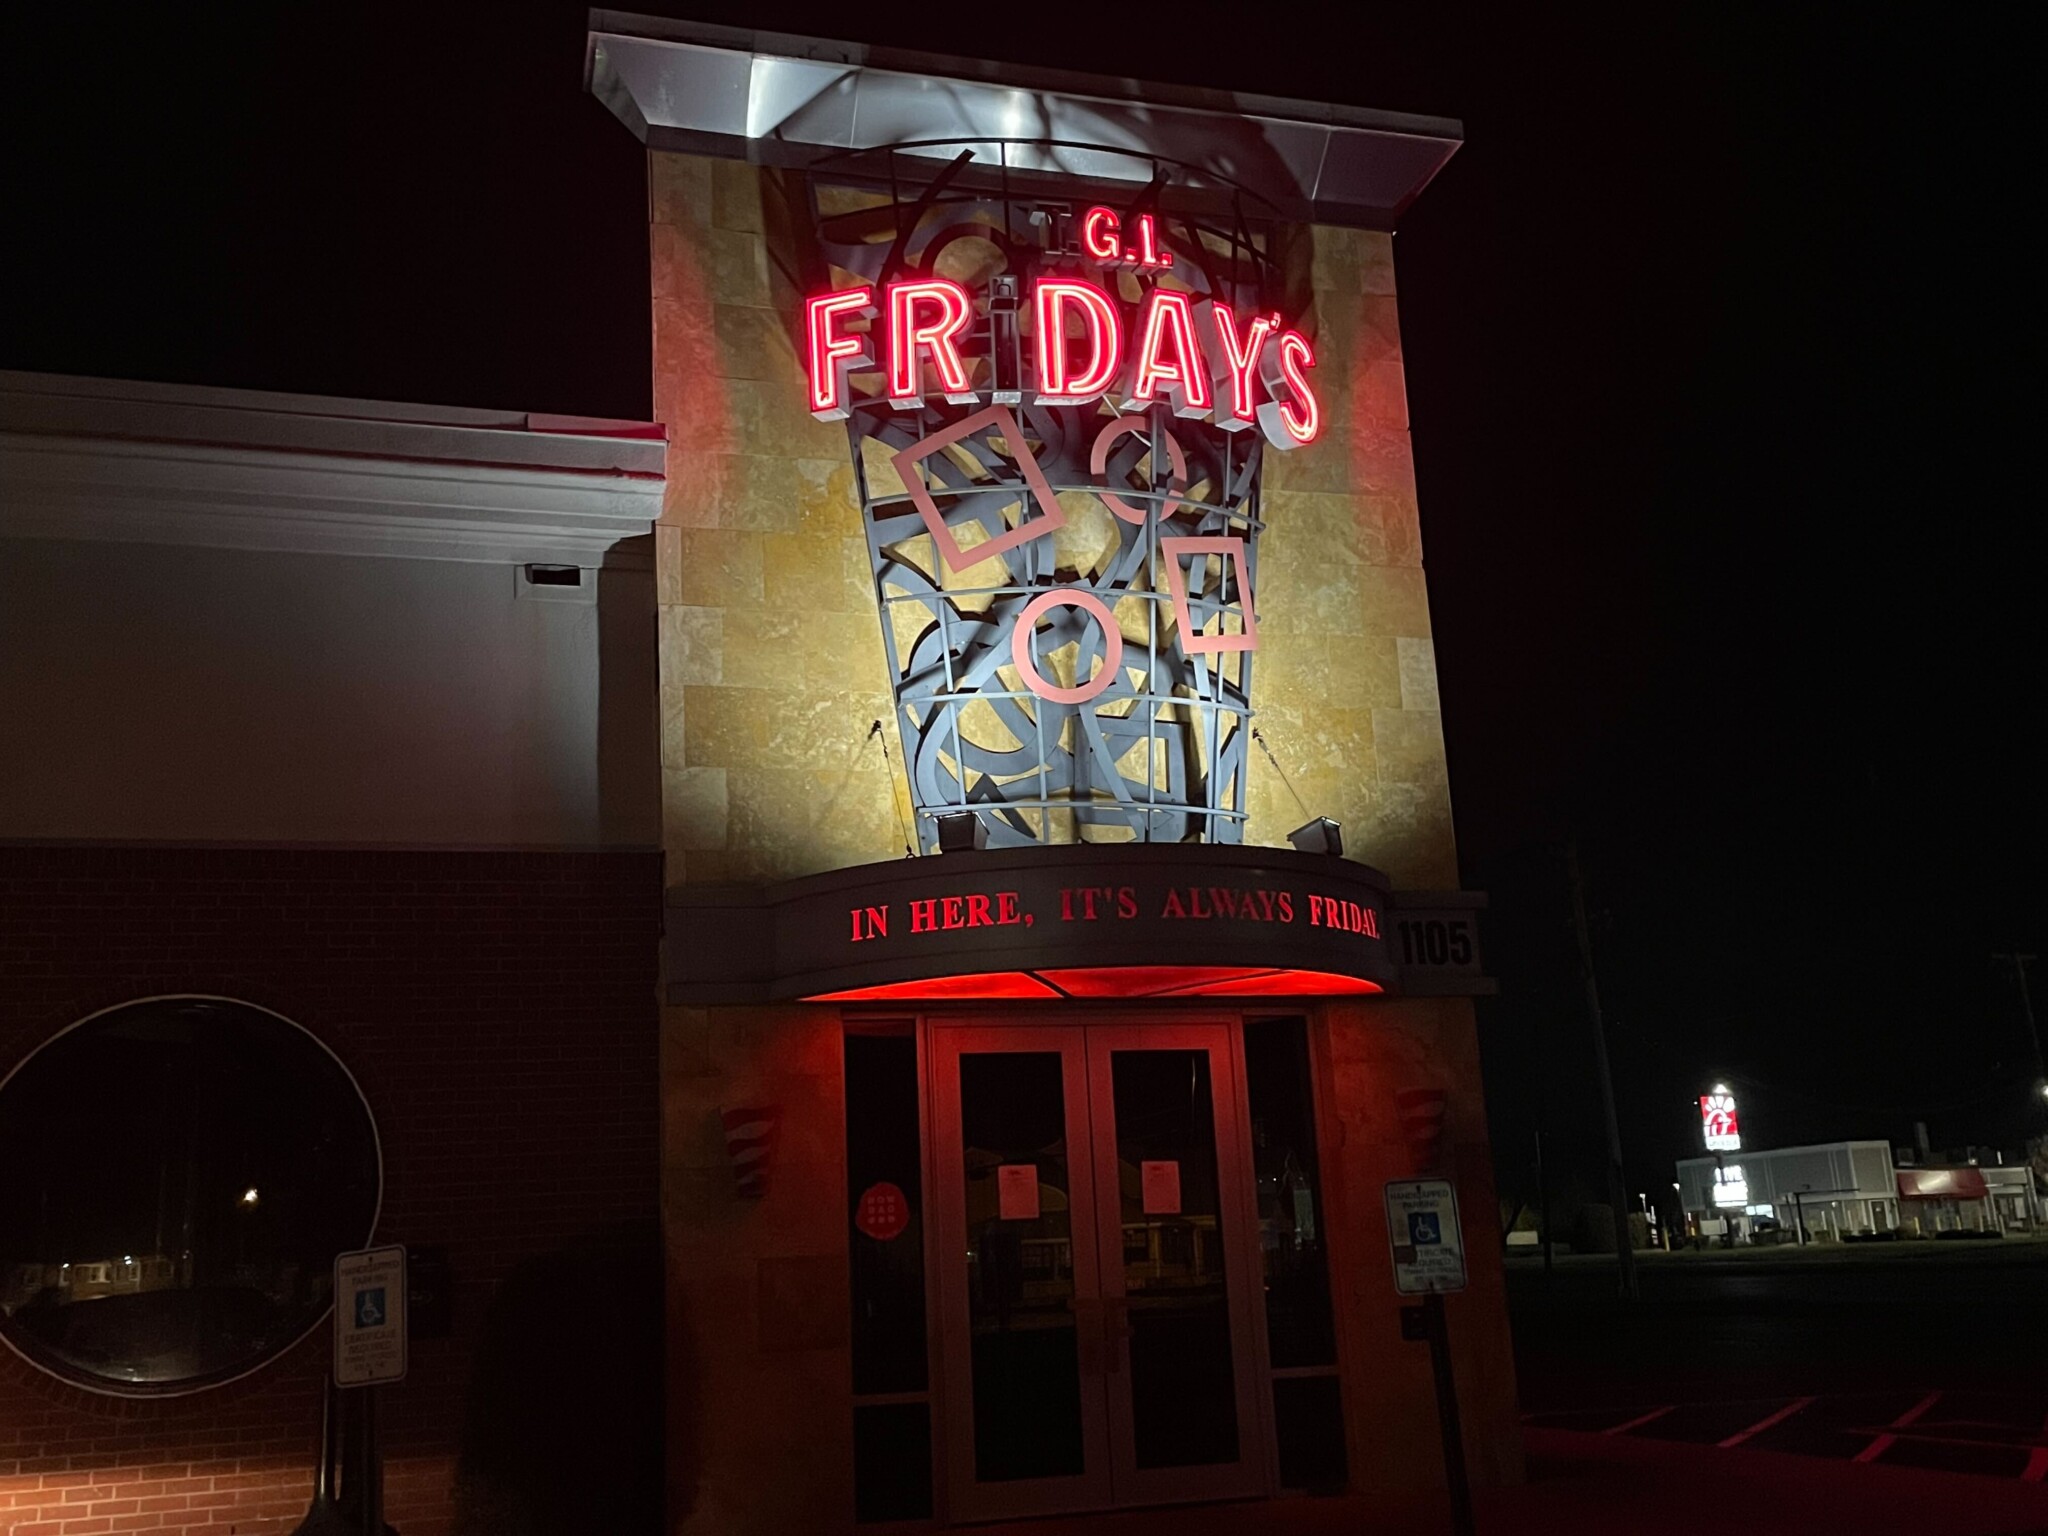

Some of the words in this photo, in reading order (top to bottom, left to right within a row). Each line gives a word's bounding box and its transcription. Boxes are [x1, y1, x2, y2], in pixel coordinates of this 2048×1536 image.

[850, 905, 889, 942] IN
[909, 891, 1034, 934] HERE,
[1059, 886, 1139, 921] IT'S
[1161, 886, 1294, 923] ALWAYS
[1397, 920, 1472, 966] 1105
